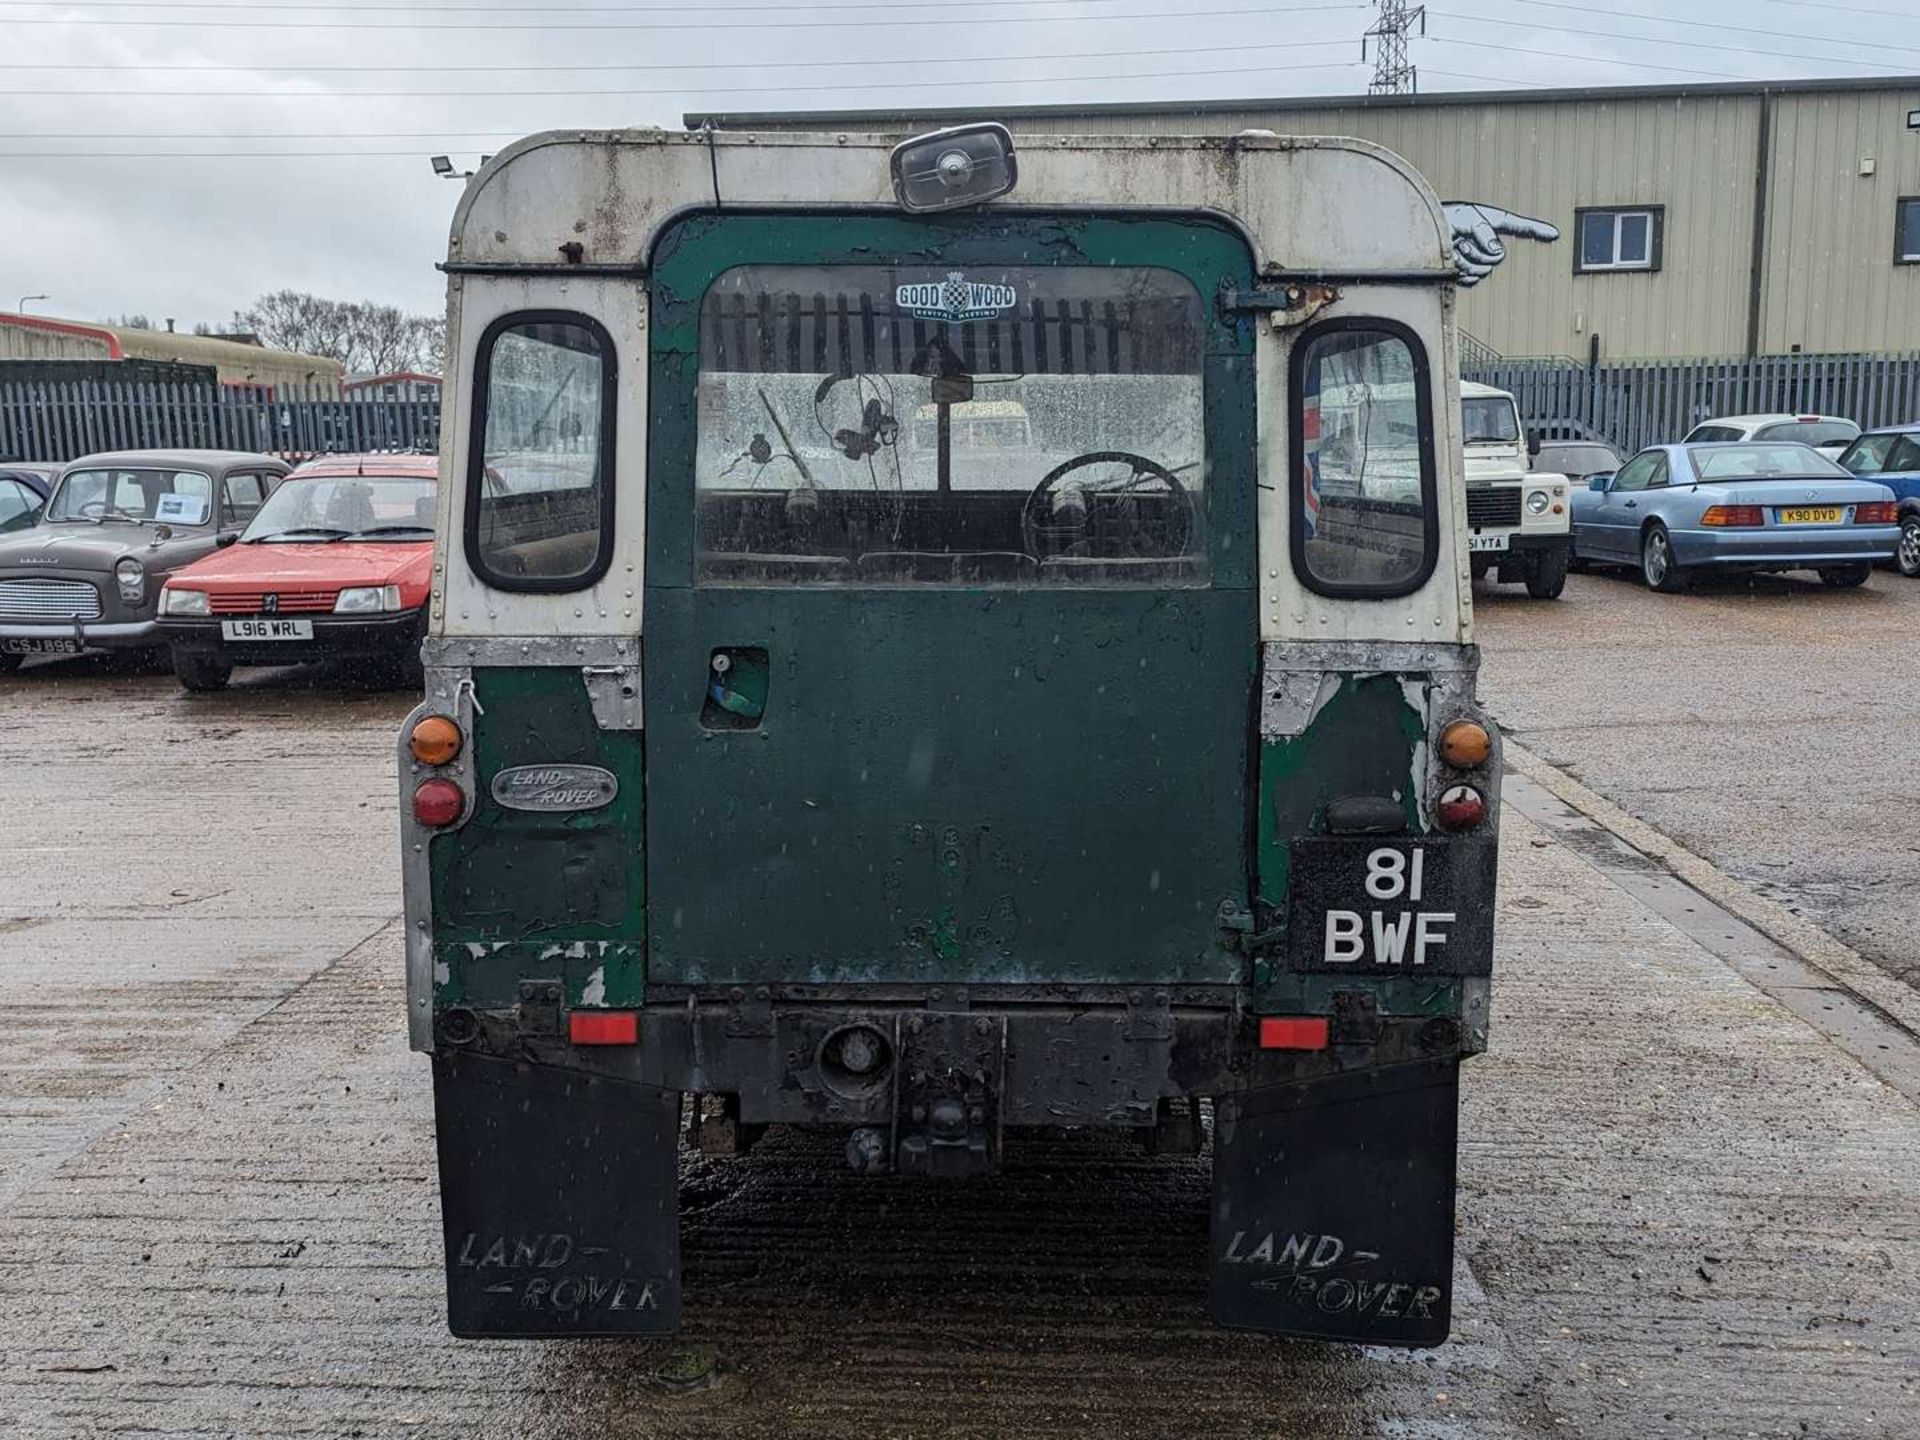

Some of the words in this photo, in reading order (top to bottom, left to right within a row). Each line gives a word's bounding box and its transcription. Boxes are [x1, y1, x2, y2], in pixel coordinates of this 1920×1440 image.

[900, 286, 939, 306] GOOD
[970, 286, 1013, 307] WOOD
[1788, 509, 1811, 521] K90
[1813, 509, 1836, 521] DVD
[1480, 537, 1502, 549] YTA
[232, 622, 267, 636] L916
[271, 622, 302, 636] WRL
[1364, 847, 1424, 901] 81
[1324, 909, 1457, 965] BWF
